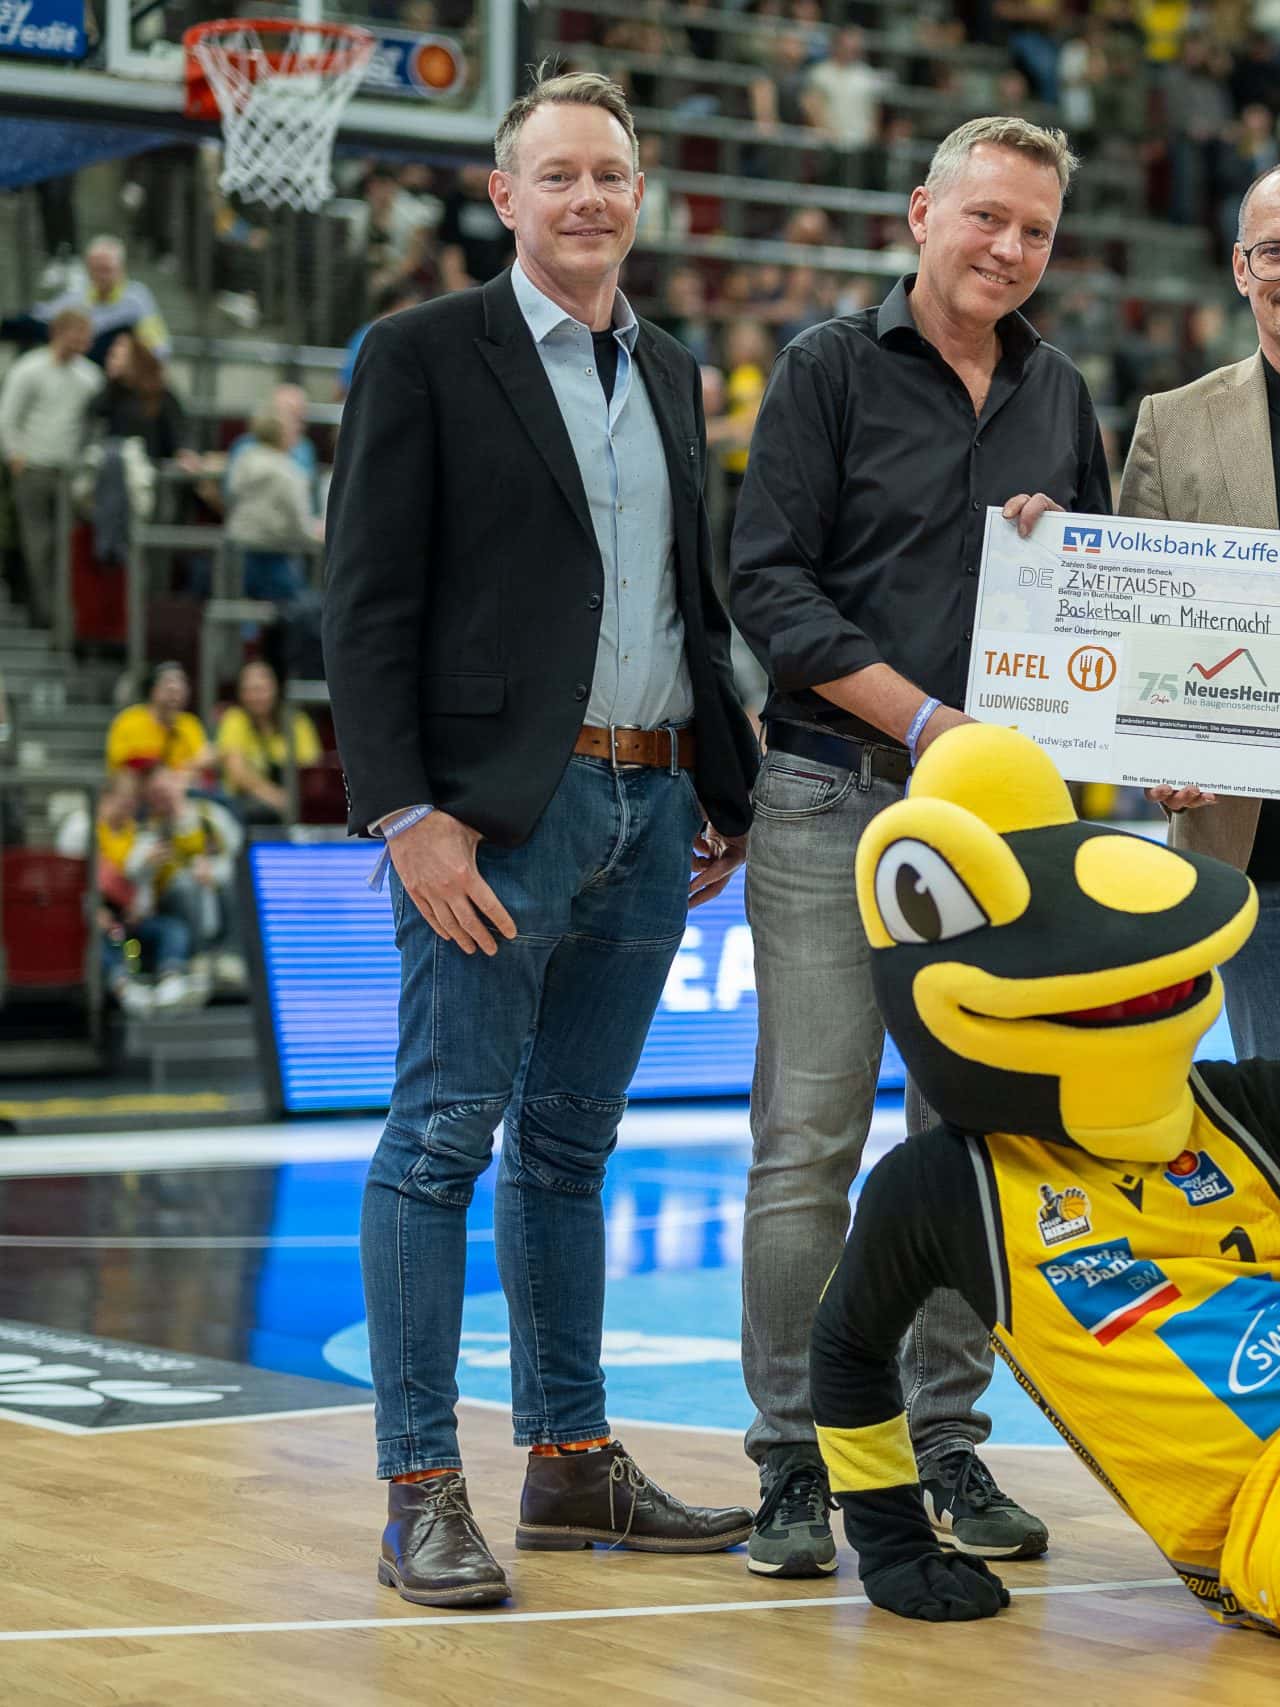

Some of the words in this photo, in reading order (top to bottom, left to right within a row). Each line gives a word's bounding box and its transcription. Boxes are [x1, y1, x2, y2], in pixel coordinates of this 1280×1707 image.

[1107, 530, 1217, 558] Volksbank
[1018, 566, 1054, 589] DE
[1060, 560, 1085, 569] Zahlen
[1098, 565, 1121, 573] gegen
[1122, 566, 1146, 574] diesen
[1147, 568, 1172, 576] Scheck
[1058, 588, 1081, 598] Betrag
[1091, 590, 1133, 601] Buchstaben
[1066, 569, 1196, 598] ZWEITAUSEND
[1056, 599, 1141, 624] Basketball
[1150, 612, 1171, 625] um
[1180, 604, 1271, 634] Mitternacht
[1053, 625, 1073, 633] oder
[1074, 625, 1121, 637] Überbringer
[984, 650, 1050, 679] TAFEL
[1138, 671, 1179, 701] 75
[978, 692, 1070, 714] LUDWIGSBURG
[1183, 697, 1198, 706] Die
[1139, 776, 1161, 784] dieses
[1233, 784, 1246, 792] und
[1190, 1180, 1228, 1202] BBL
[1046, 1249, 1130, 1286] Sparda
[1128, 1264, 1159, 1290] BW
